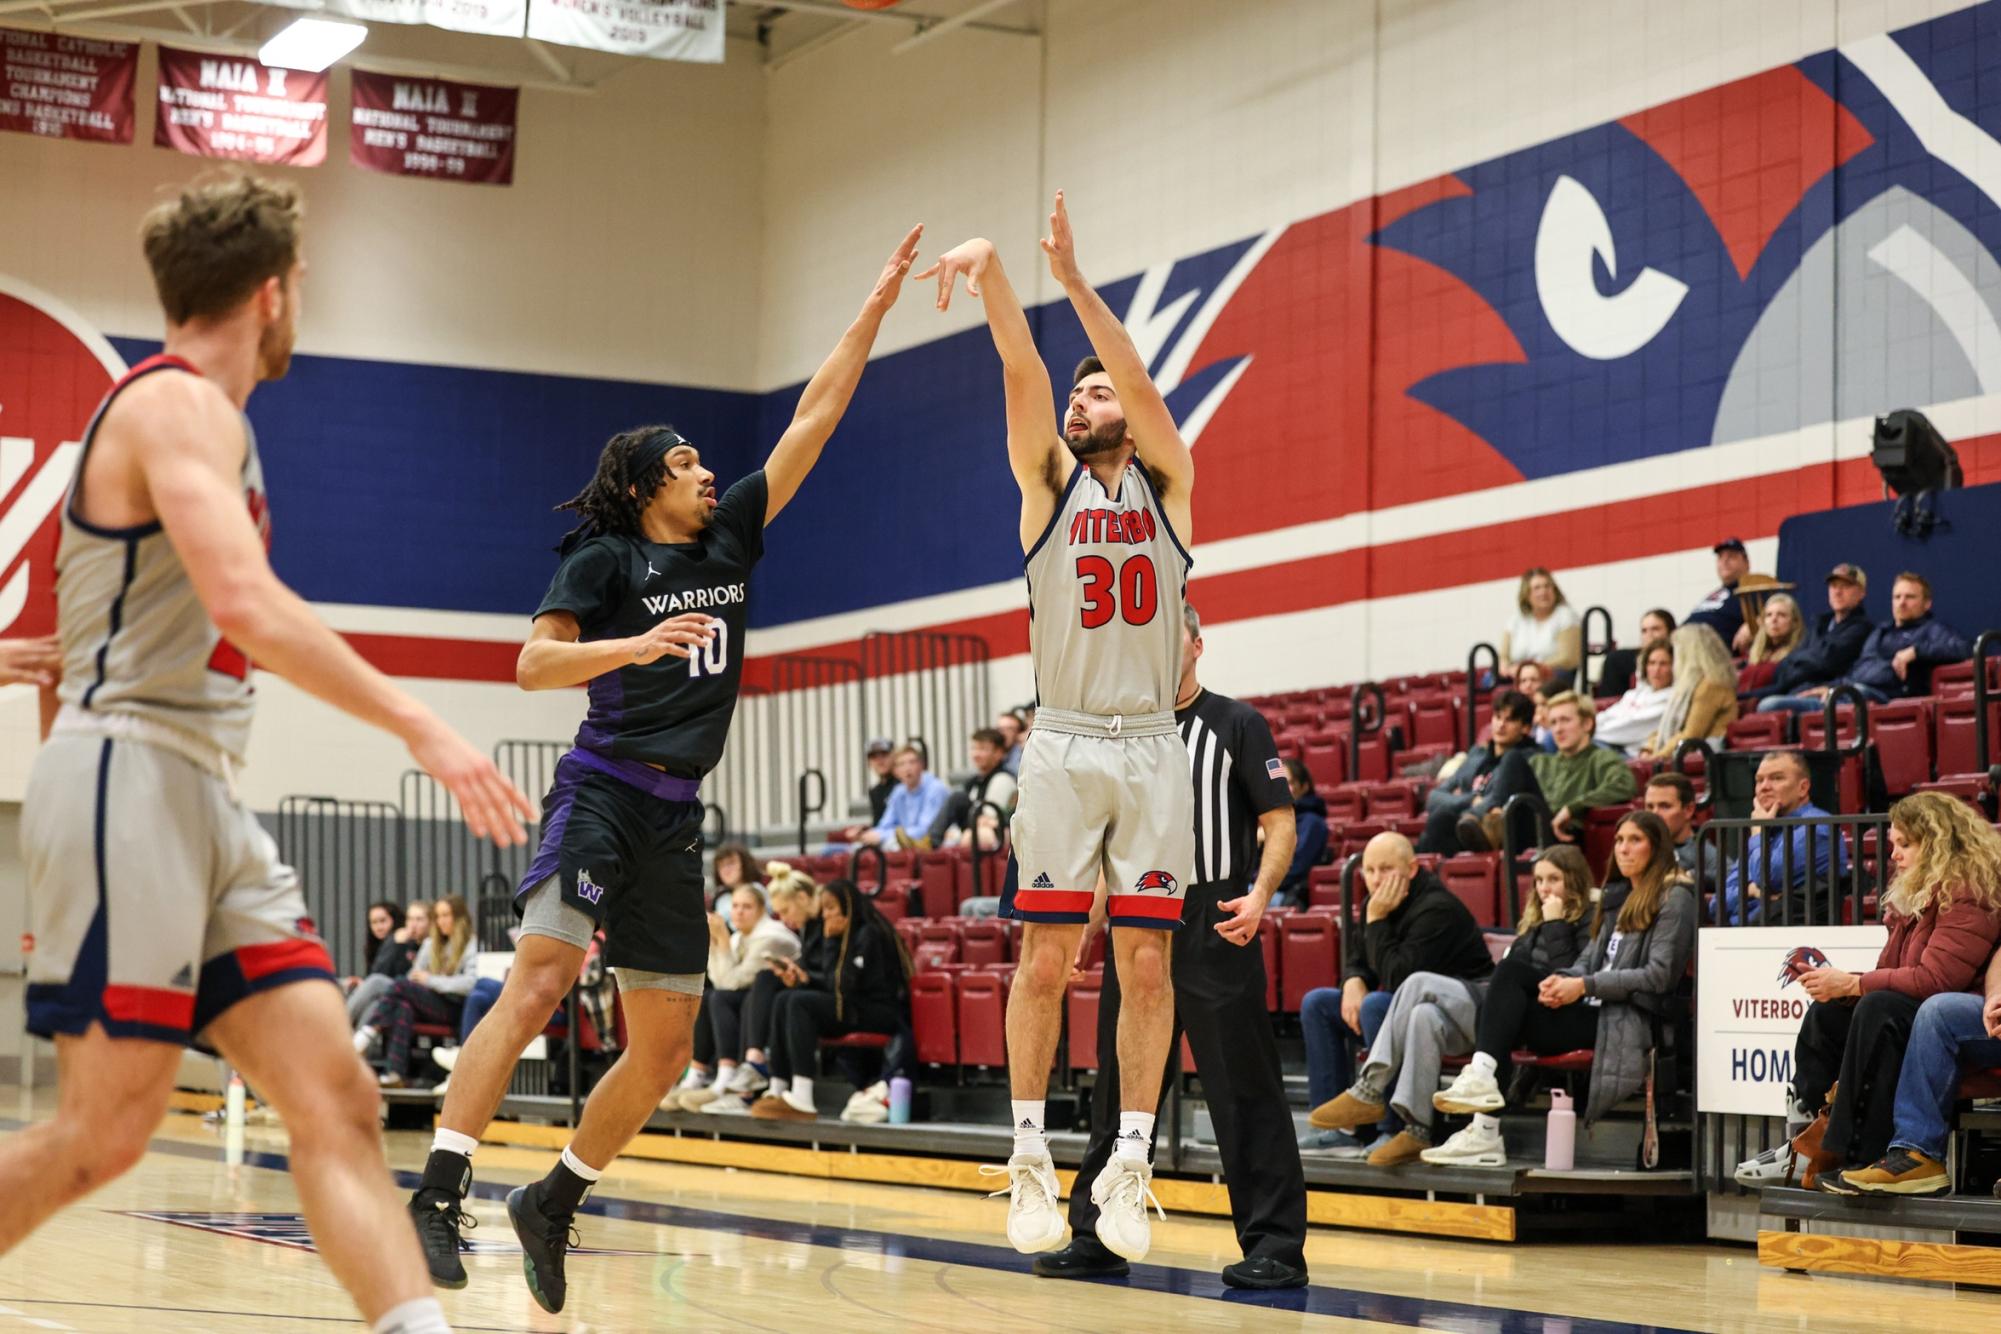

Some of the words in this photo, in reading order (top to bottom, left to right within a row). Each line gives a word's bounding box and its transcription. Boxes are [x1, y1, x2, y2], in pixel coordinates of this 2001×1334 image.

[620, 8, 706, 31] VOLLEYBALL
[6, 47, 98, 73] BASKETBALL
[57, 37, 127, 58] CATHOLIC
[5, 64, 98, 91] TOURNAMENT
[200, 60, 259, 93] NAIA
[10, 82, 91, 108] CHAMPIONS
[159, 85, 228, 111] NATIONAL
[234, 94, 327, 120] TOURNAMENT
[393, 83, 450, 114] NAIA
[25, 102, 115, 130] BASKETBALL
[170, 107, 214, 129] MEN'S
[221, 113, 312, 139] BASKETBALL
[352, 106, 420, 132] NATIONAL
[426, 115, 513, 142] TOURNAMENT
[363, 128, 408, 150] MEN'S
[416, 135, 498, 159] BASKETBALL
[642, 582, 745, 616] WARRIORS
[1075, 554, 1158, 630] 30
[687, 617, 728, 678] 10
[1732, 998, 1804, 1020] VITERBO
[1732, 1047, 1791, 1083] HOM
